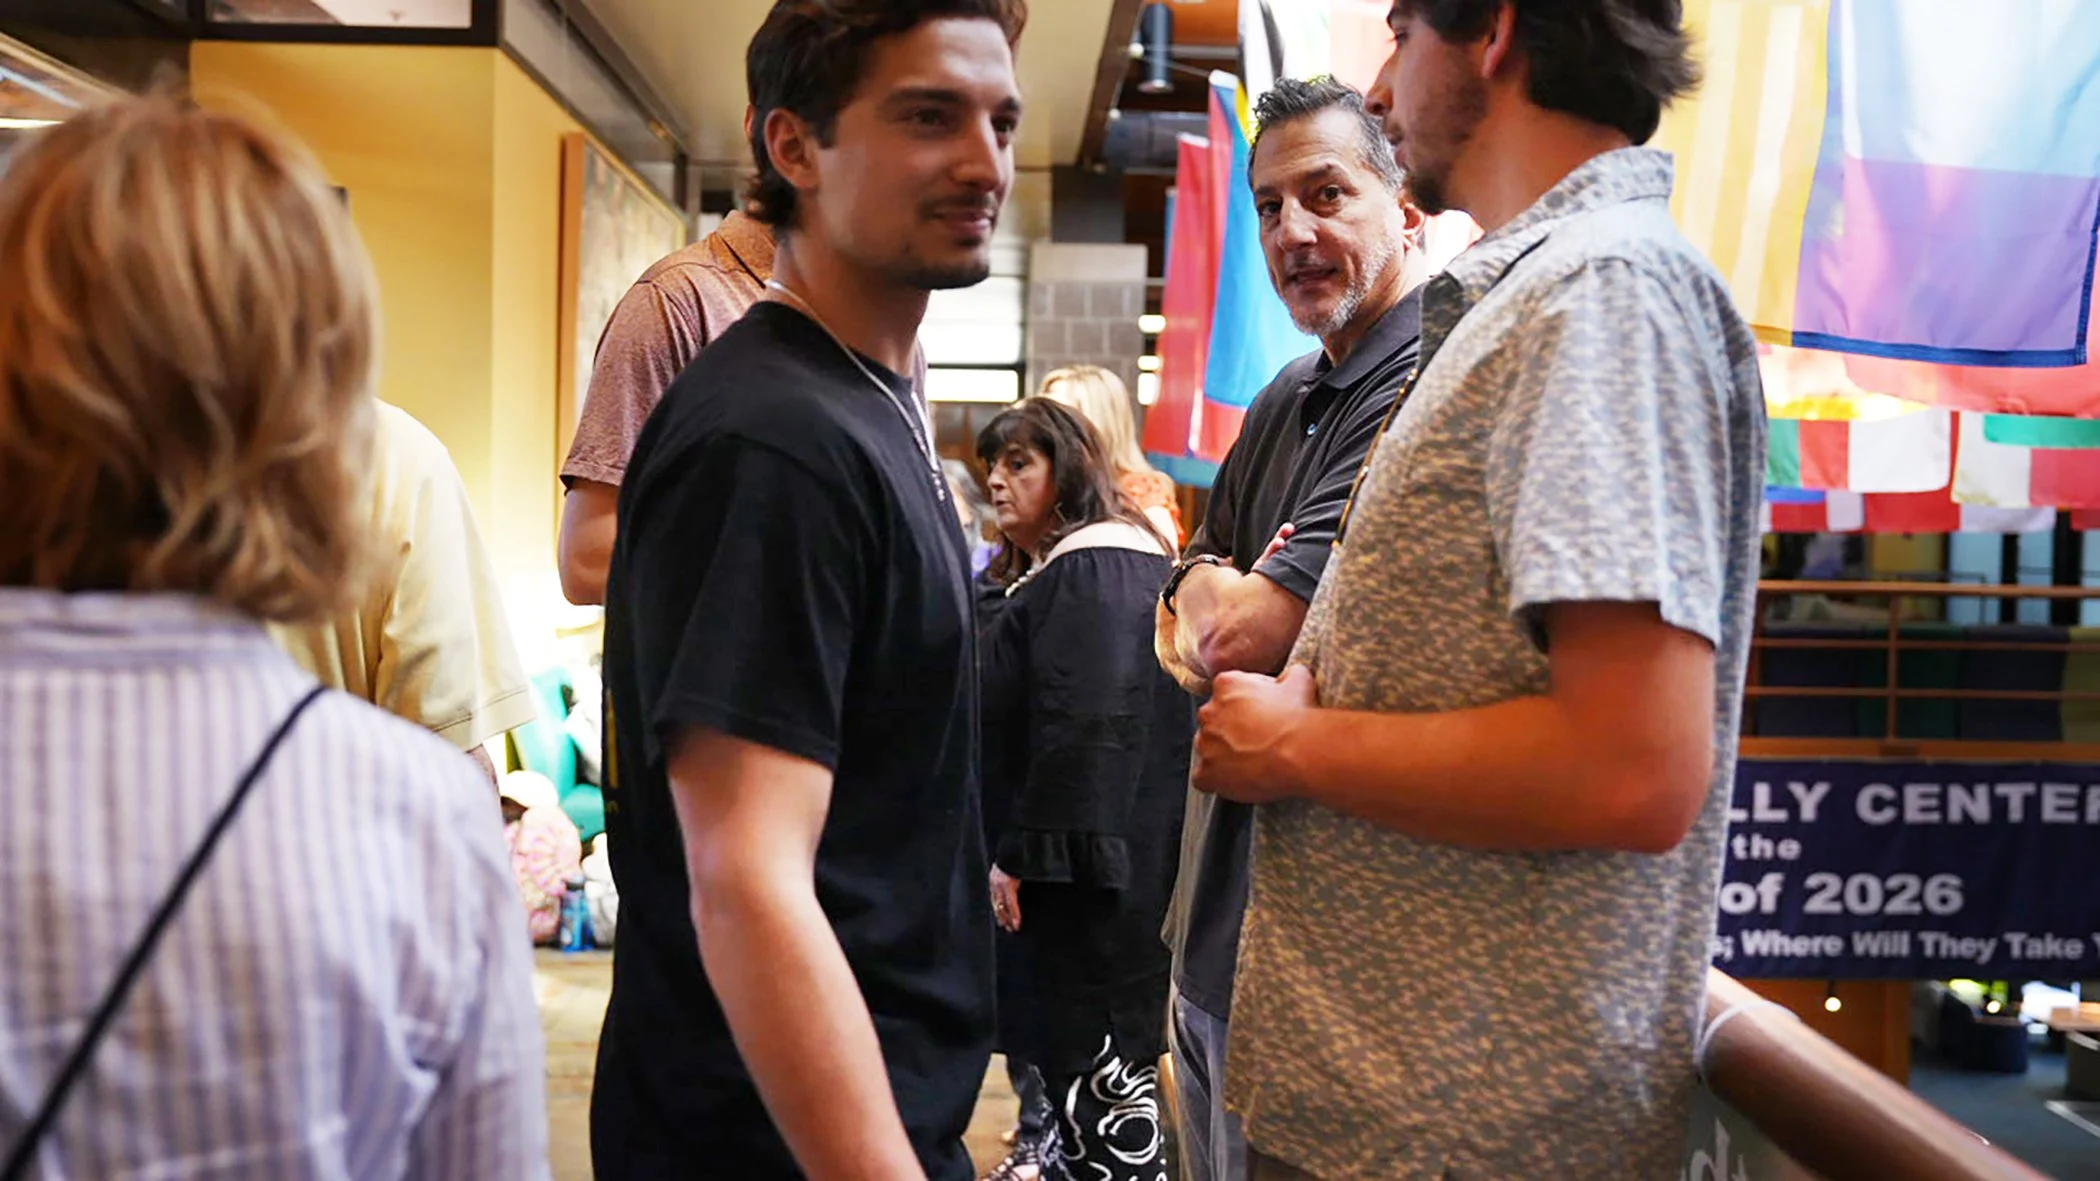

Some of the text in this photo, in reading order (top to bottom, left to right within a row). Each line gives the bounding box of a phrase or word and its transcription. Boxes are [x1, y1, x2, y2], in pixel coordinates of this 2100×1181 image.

[1731, 833, 1802, 860] the
[1719, 872, 1963, 915] of 2026
[1741, 929, 1843, 957] Where
[1852, 931, 1910, 957] Will
[1918, 932, 1997, 963] They
[2003, 932, 2085, 960] Take
